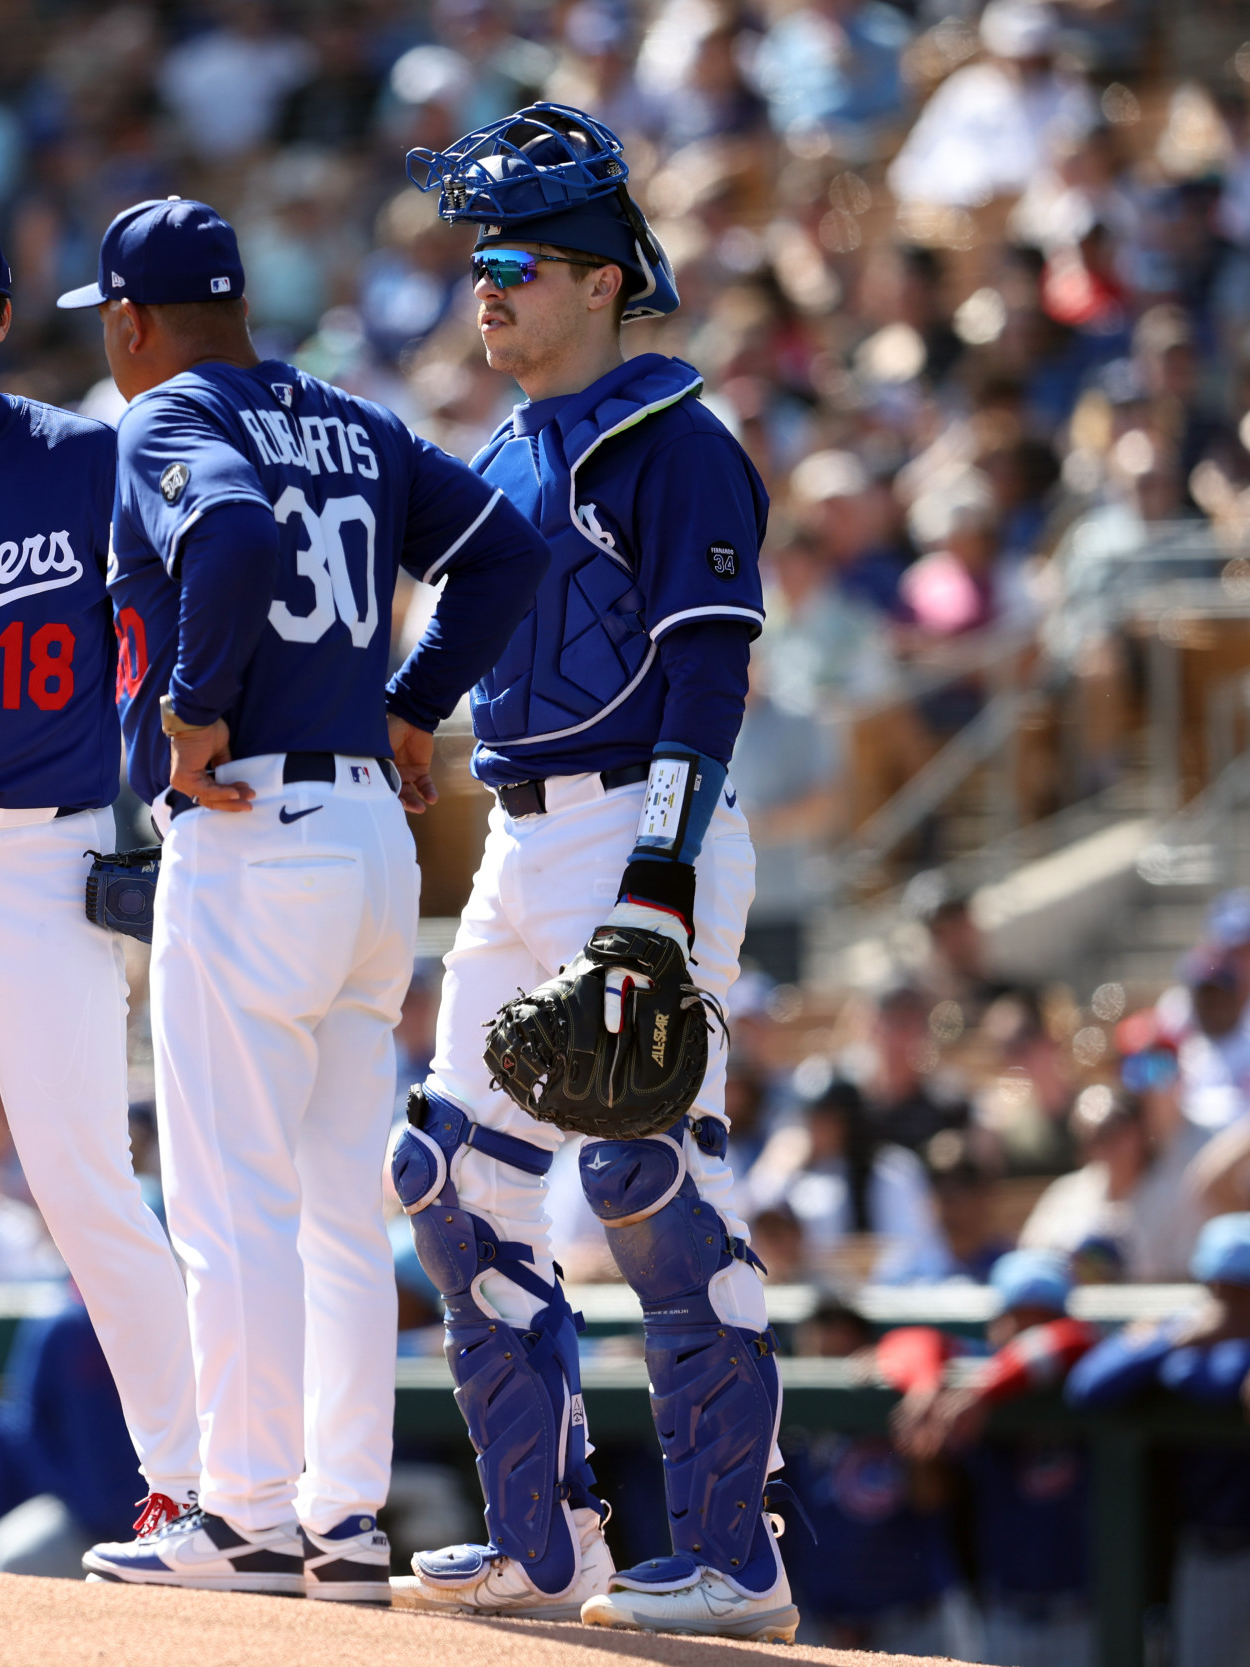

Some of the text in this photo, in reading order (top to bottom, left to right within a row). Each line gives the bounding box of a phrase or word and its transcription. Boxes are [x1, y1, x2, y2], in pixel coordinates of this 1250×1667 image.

[238, 409, 380, 480] ROBRTS
[267, 485, 379, 649] 30
[710, 547, 735, 555] FERNANDO
[713, 554, 735, 574] 34
[651, 1013, 670, 1068] ALL-STAR
